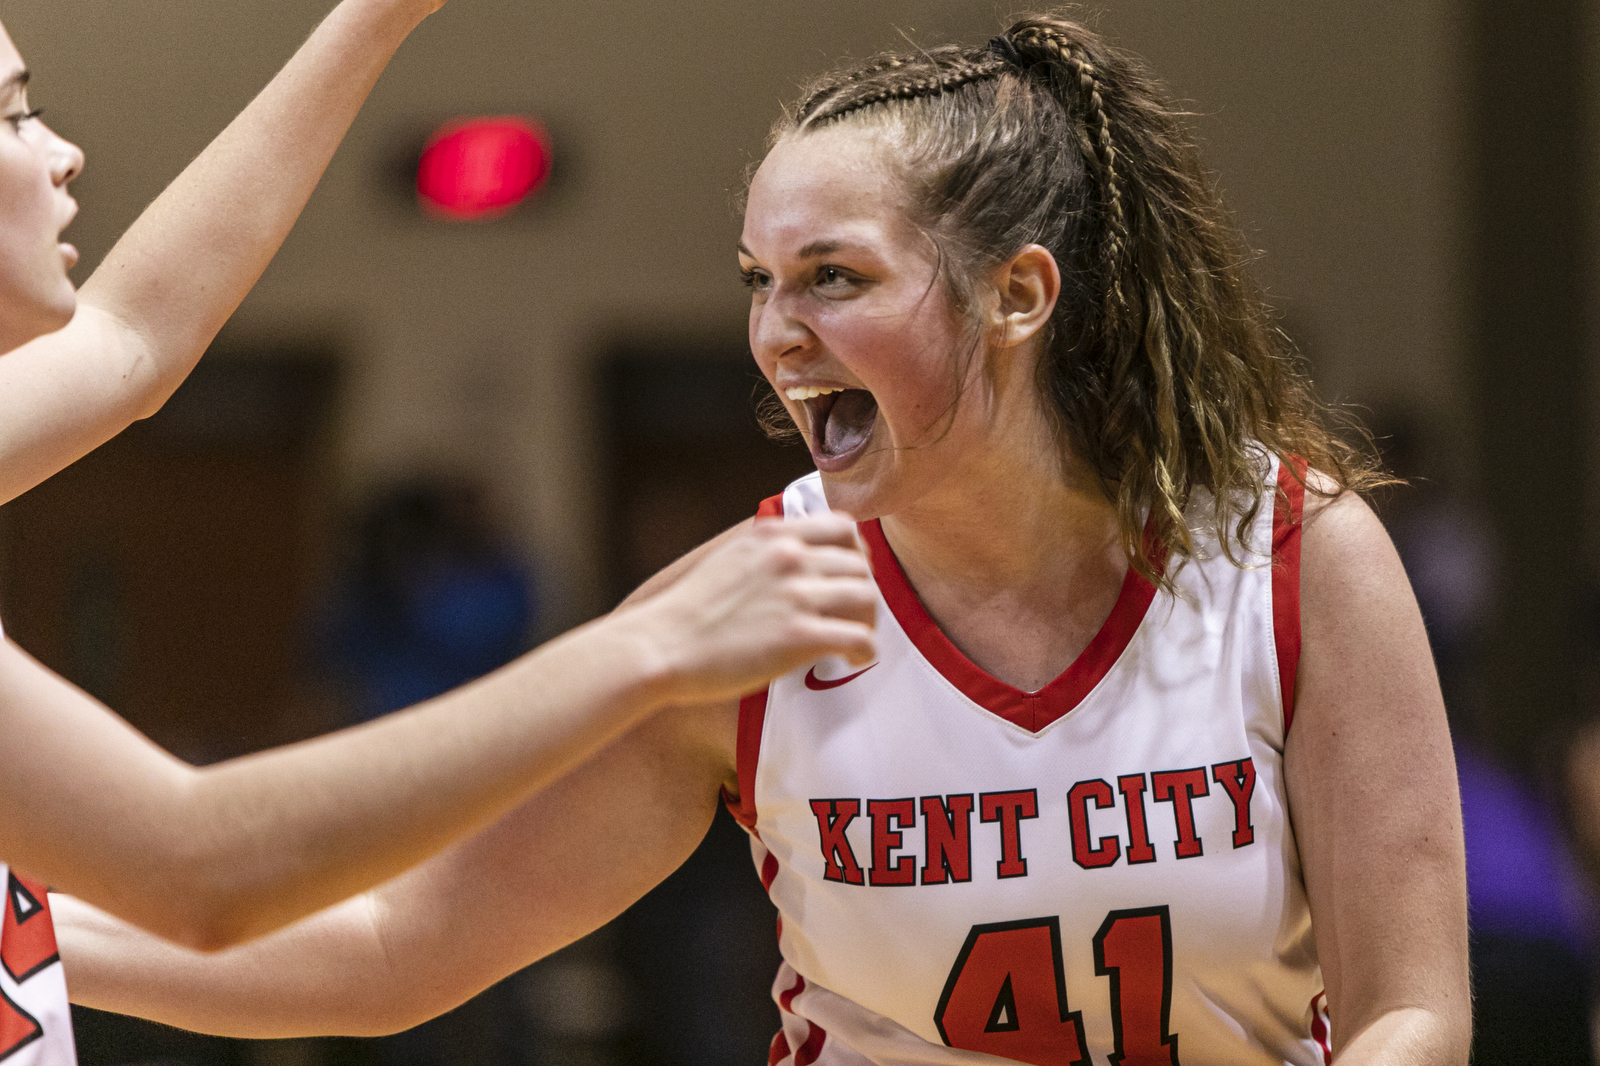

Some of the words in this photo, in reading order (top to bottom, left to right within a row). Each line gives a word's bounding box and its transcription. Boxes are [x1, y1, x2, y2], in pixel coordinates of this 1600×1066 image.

[808, 788, 1040, 887] KENT
[1066, 757, 1257, 870] CITY
[933, 904, 1181, 1066] 41
